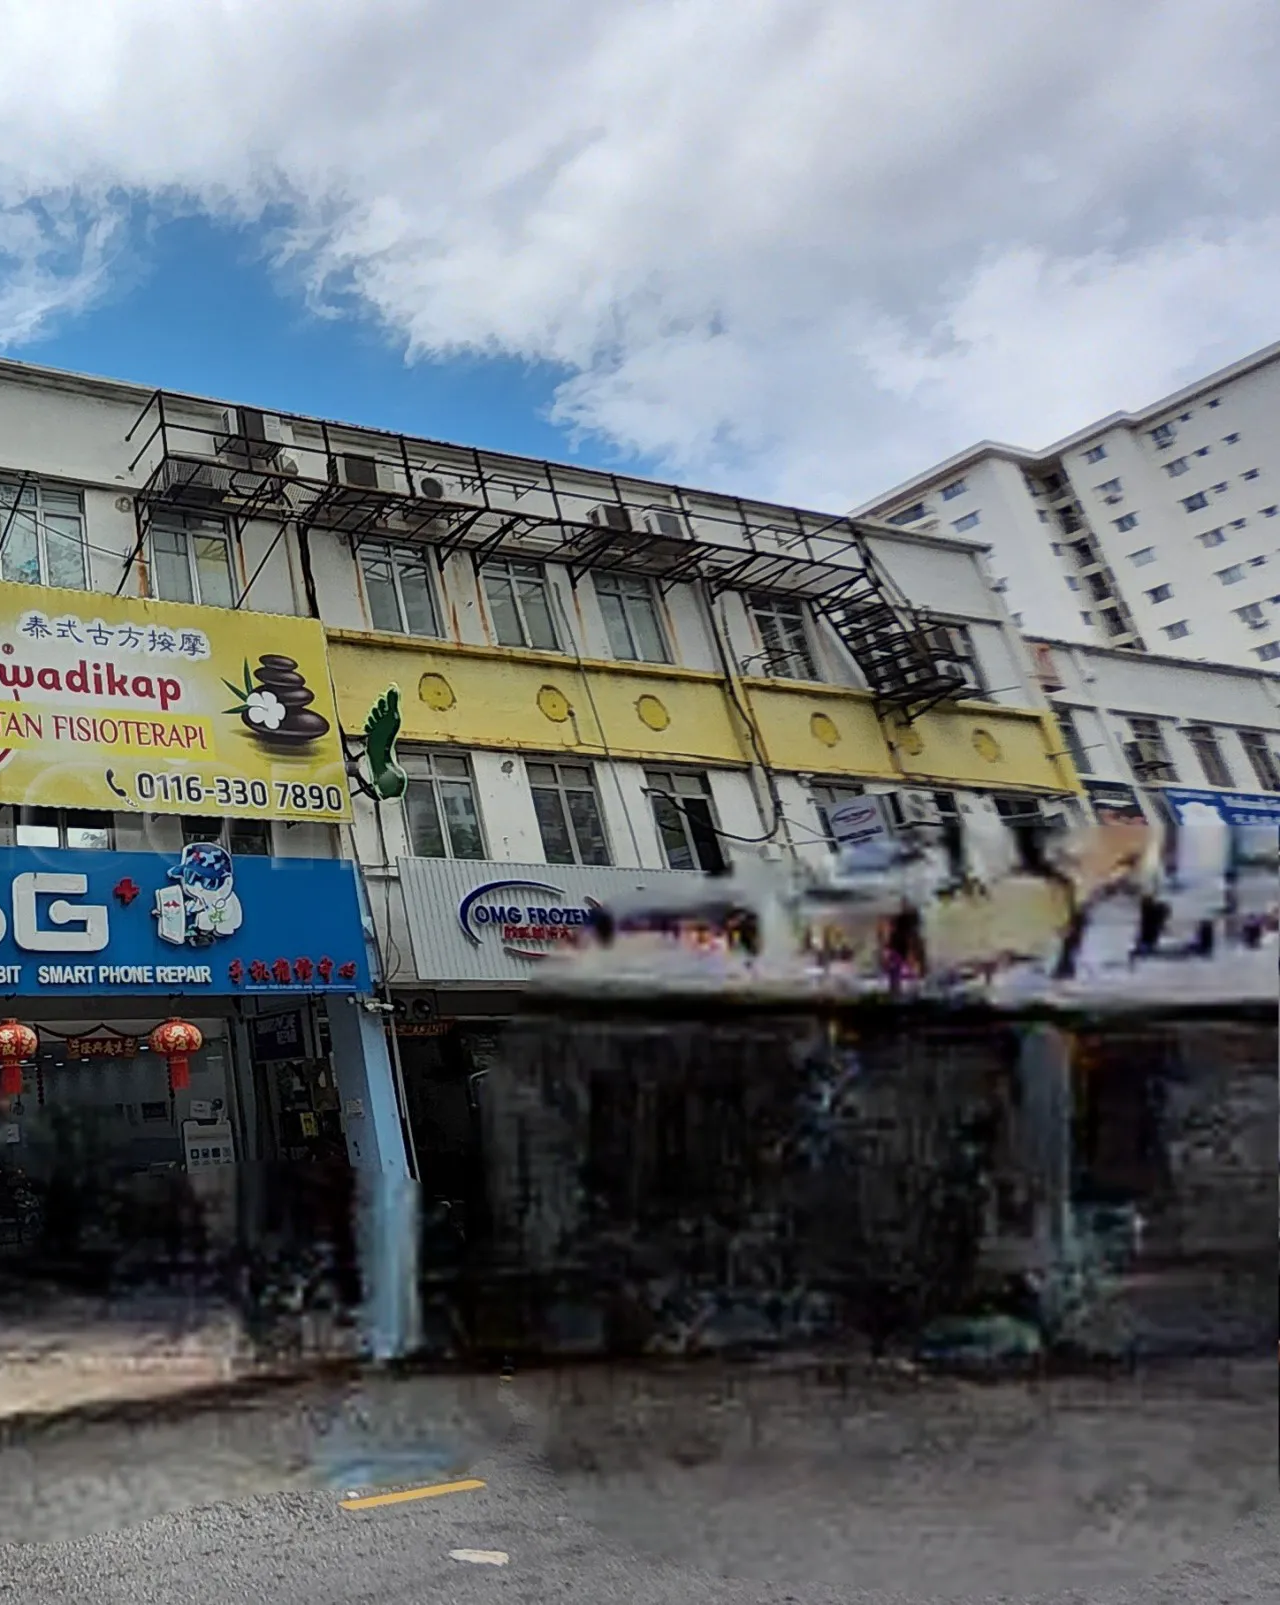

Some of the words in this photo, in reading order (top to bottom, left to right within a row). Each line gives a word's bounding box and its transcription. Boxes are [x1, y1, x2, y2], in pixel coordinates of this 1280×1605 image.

[22, 615, 207, 657] 泰式古方按摩
[53, 713, 207, 751] FISIOTERAPI
[136, 772, 268, 808] 0116-330
[275, 780, 344, 811] 7890
[474, 905, 523, 925] OMG
[37, 964, 94, 985] SMART
[98, 965, 152, 985] PHONE
[155, 965, 213, 985] REPAIR
